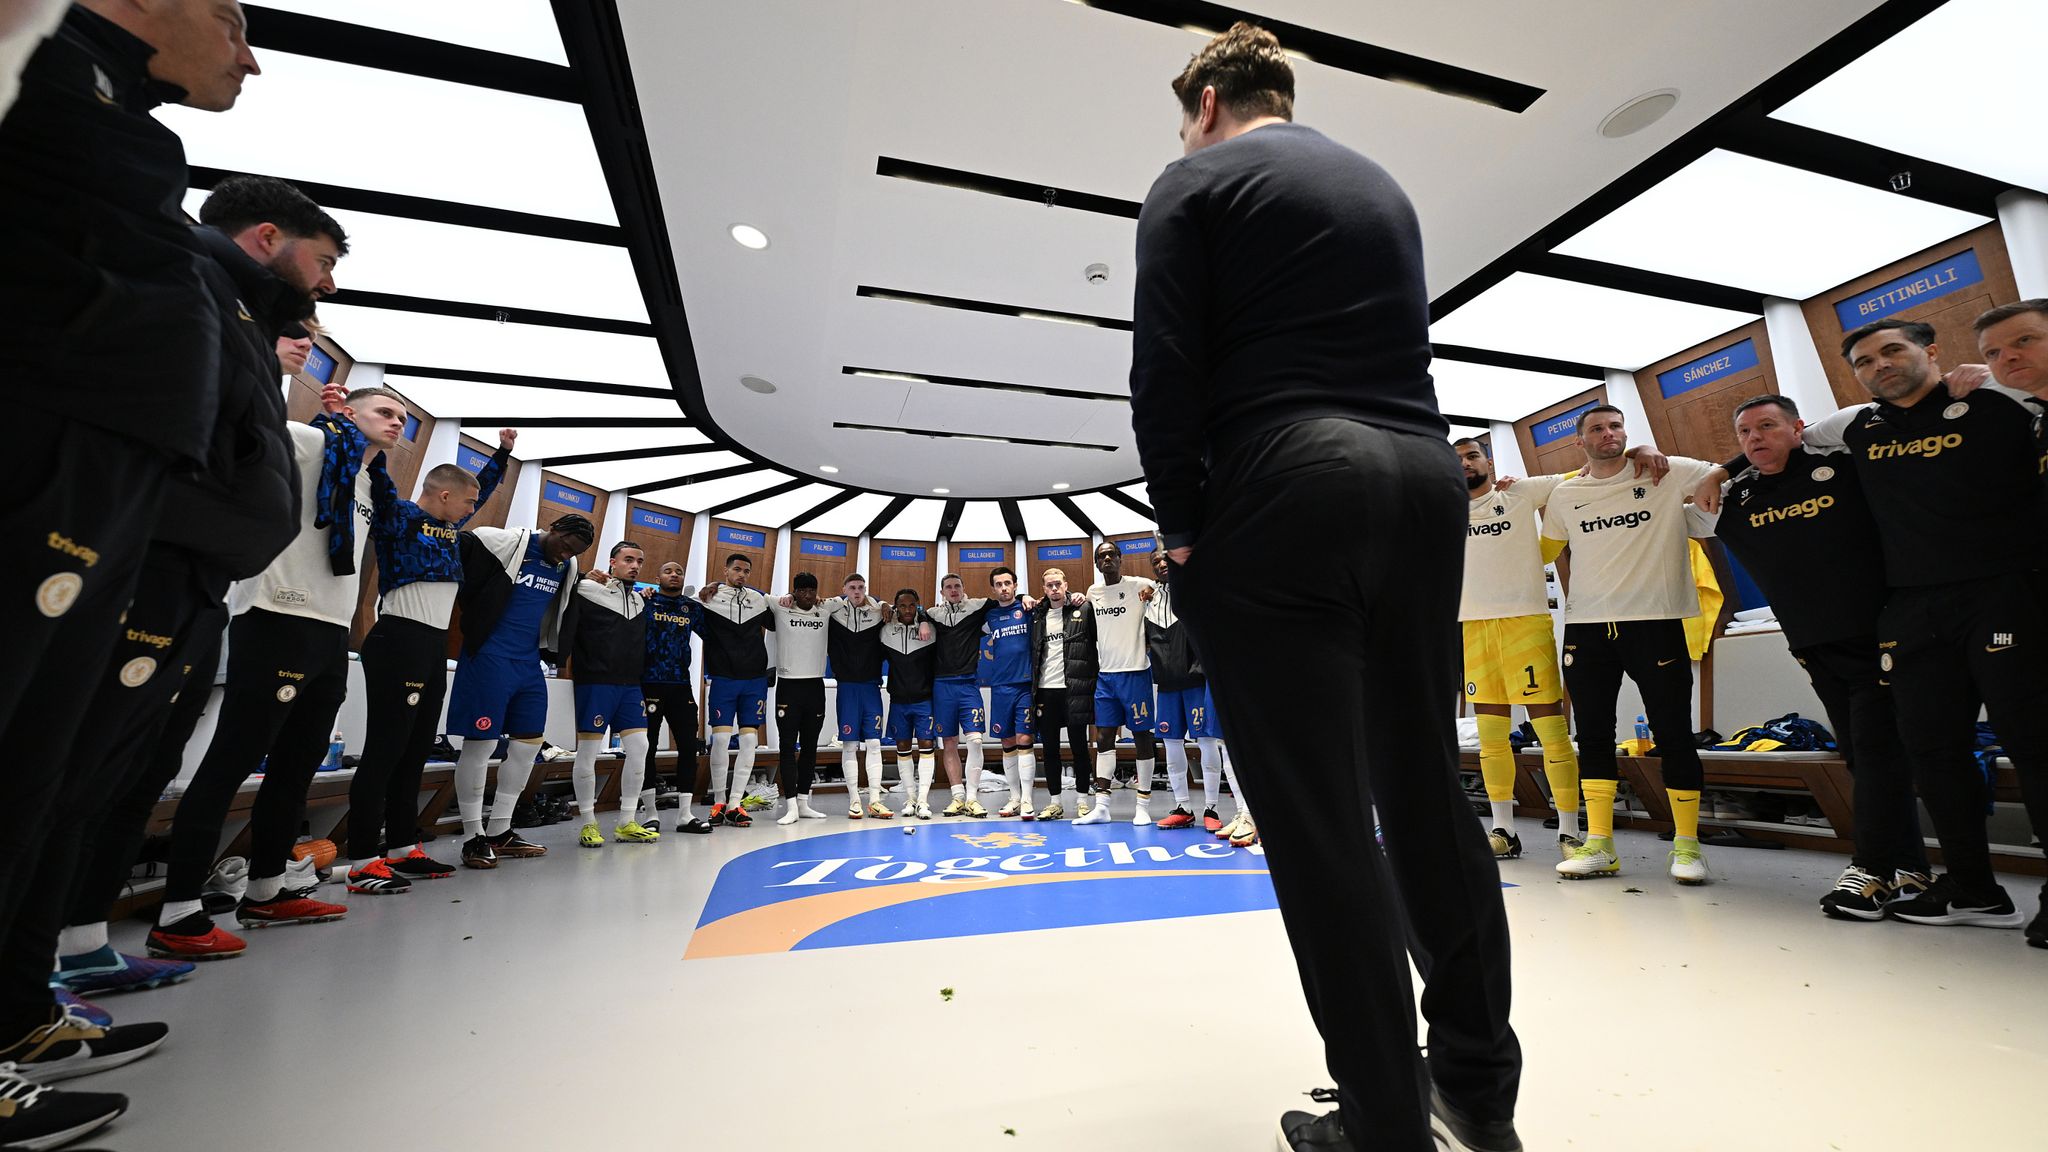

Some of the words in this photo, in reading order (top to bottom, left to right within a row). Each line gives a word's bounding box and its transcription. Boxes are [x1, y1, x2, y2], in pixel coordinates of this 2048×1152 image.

[1858, 267, 1959, 316] BETTINELLI
[1683, 356, 1732, 383] SÁNCHEZ
[1867, 433, 1963, 461] trivago
[469, 456, 488, 470] GUST
[557, 490, 581, 504] NKUNKU
[1749, 495, 1835, 528] trivago
[643, 514, 668, 528] COLWILL
[1579, 510, 1652, 534] trivago
[421, 522, 458, 544] trivag
[1468, 520, 1512, 537] ivago
[729, 532, 753, 543] MADUEKE
[813, 543, 834, 552] PALMER
[1047, 549, 1073, 557] CHILWELL
[1125, 542, 1152, 551] CHALOBAH
[890, 550, 917, 558] STERLING
[1095, 606, 1126, 617] trivago
[653, 611, 691, 627] trivago
[789, 618, 824, 630] trivago
[1001, 623, 1028, 632] INFINITE
[1001, 629, 1028, 638] ATHLETE
[1992, 632, 2013, 645] HH
[1524, 665, 1539, 689] 1
[971, 708, 984, 723] 23
[1131, 701, 1149, 720] 14
